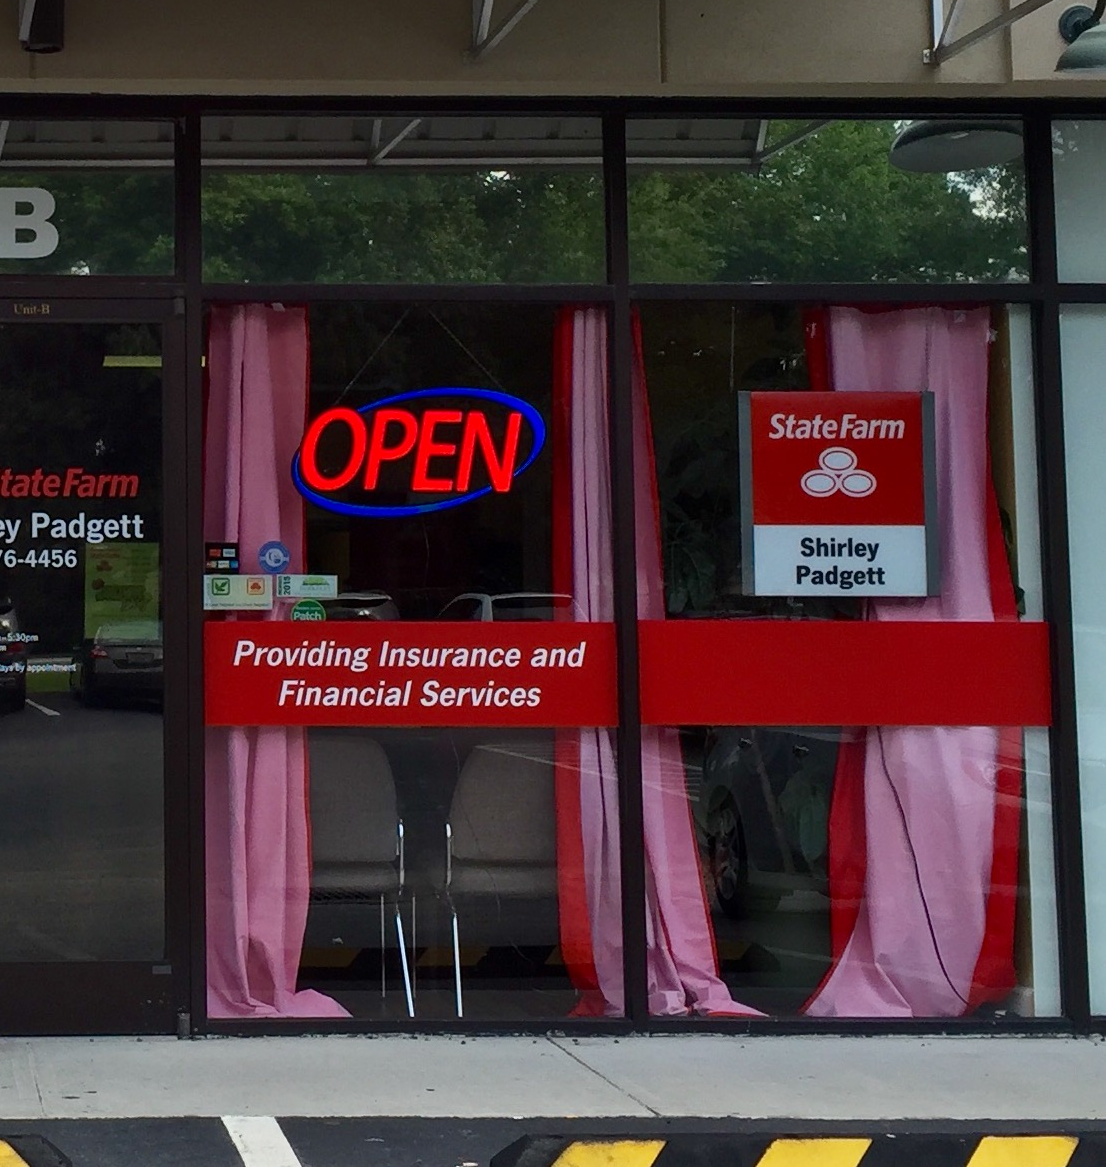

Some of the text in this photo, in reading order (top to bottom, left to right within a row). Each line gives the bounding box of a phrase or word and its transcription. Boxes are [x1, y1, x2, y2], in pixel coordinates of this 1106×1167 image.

[13, 303, 51, 315] Unit-B
[298, 407, 523, 493] OPEN
[31, 512, 144, 543] Padgett
[800, 537, 880, 562] Shirley
[796, 565, 886, 590] Padgett
[294, 611, 322, 621] Patch
[26, 663, 77, 673] appointment
[233, 640, 587, 672] Providing Insurance and
[278, 679, 542, 707] Financial Services
